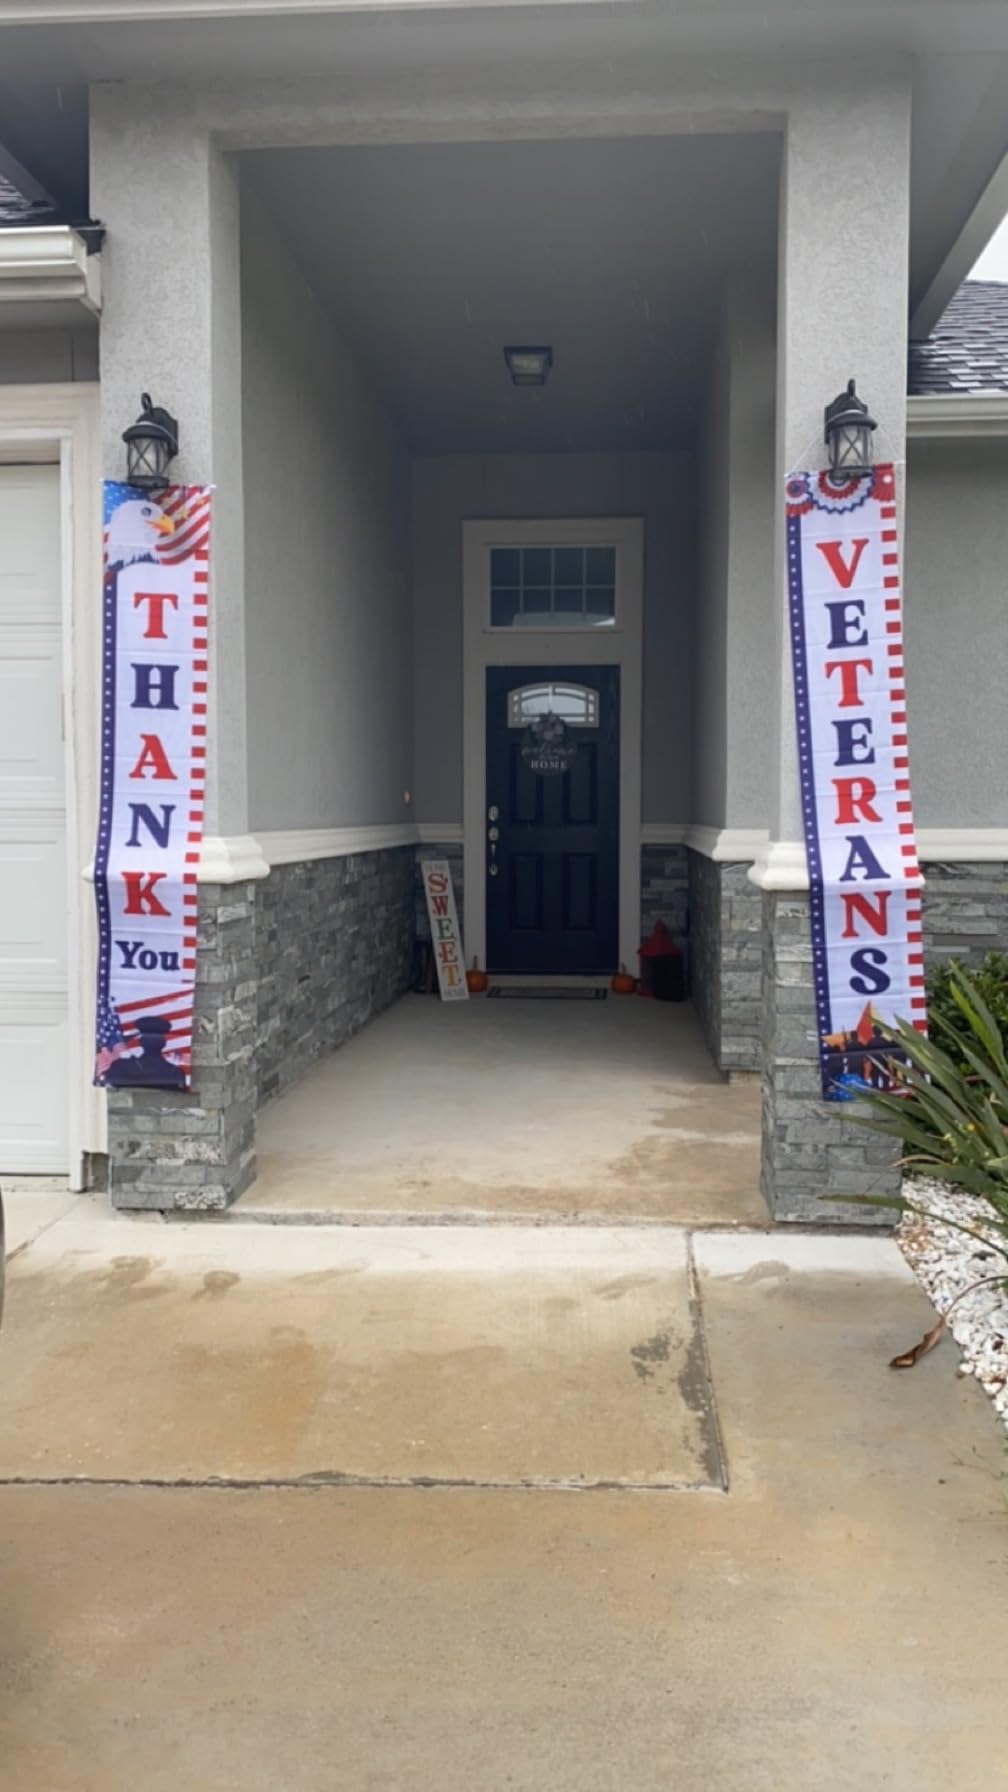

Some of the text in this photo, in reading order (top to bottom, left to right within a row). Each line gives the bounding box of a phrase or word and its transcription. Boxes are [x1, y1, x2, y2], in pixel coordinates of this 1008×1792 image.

[121, 593, 180, 916] THANK
[531, 760, 567, 769] HOME
[817, 539, 891, 995] VETERANS
[115, 941, 180, 971] You
[428, 873, 459, 986] SWEET
